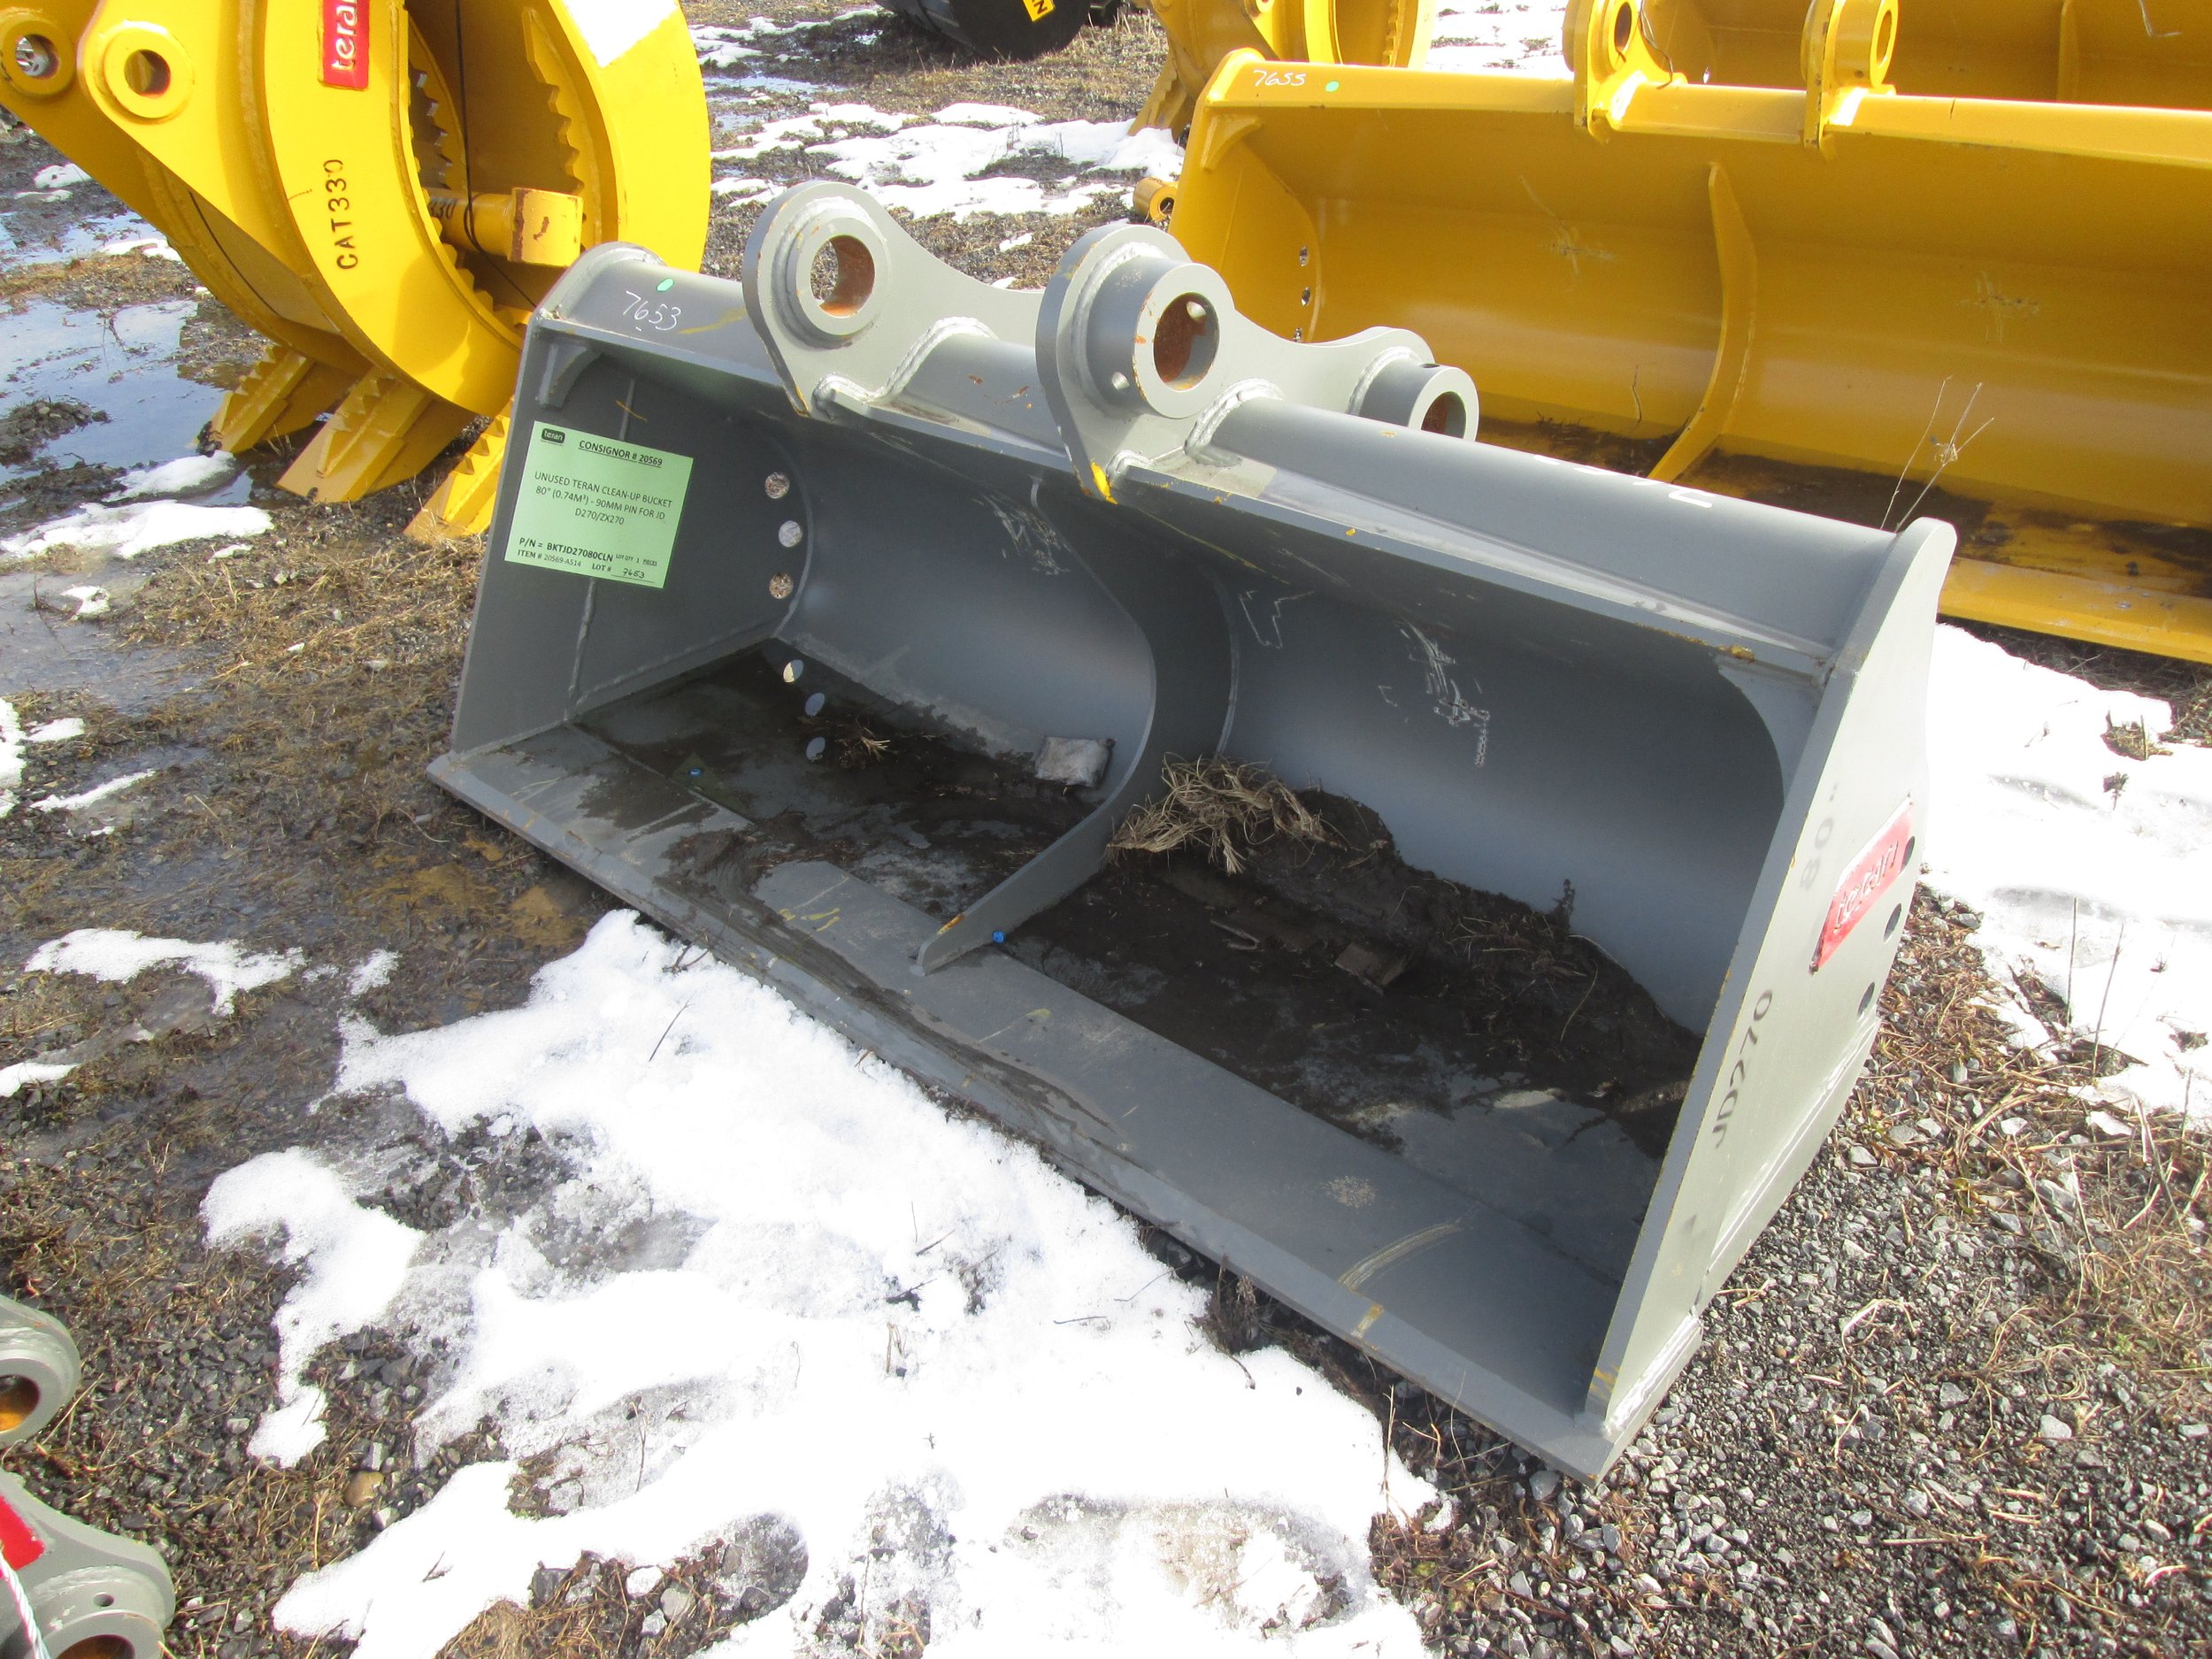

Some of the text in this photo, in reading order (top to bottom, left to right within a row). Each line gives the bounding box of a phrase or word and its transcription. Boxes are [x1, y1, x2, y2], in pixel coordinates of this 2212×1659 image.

[331, 0, 358, 71] tera
[623, 290, 681, 331] 7653
[543, 429, 564, 442] teran
[579, 440, 631, 460] CONSIGNOR
[639, 454, 663, 466] 20569
[534, 471, 672, 508] UNUSED TERAN CLEAN-UP BUCKET
[535, 486, 550, 495] 80"
[595, 498, 623, 511] 90MM
[624, 505, 637, 515] PIN
[639, 507, 654, 518] FOR
[655, 511, 666, 520] JD
[575, 508, 625, 526] D270/ZX270
[518, 537, 536, 548] P/N
[547, 542, 613, 562] BKTJD27080CLN
[518, 549, 536, 559] ITEM
[592, 563, 606, 572] LOT
[623, 567, 645, 579] 7653
